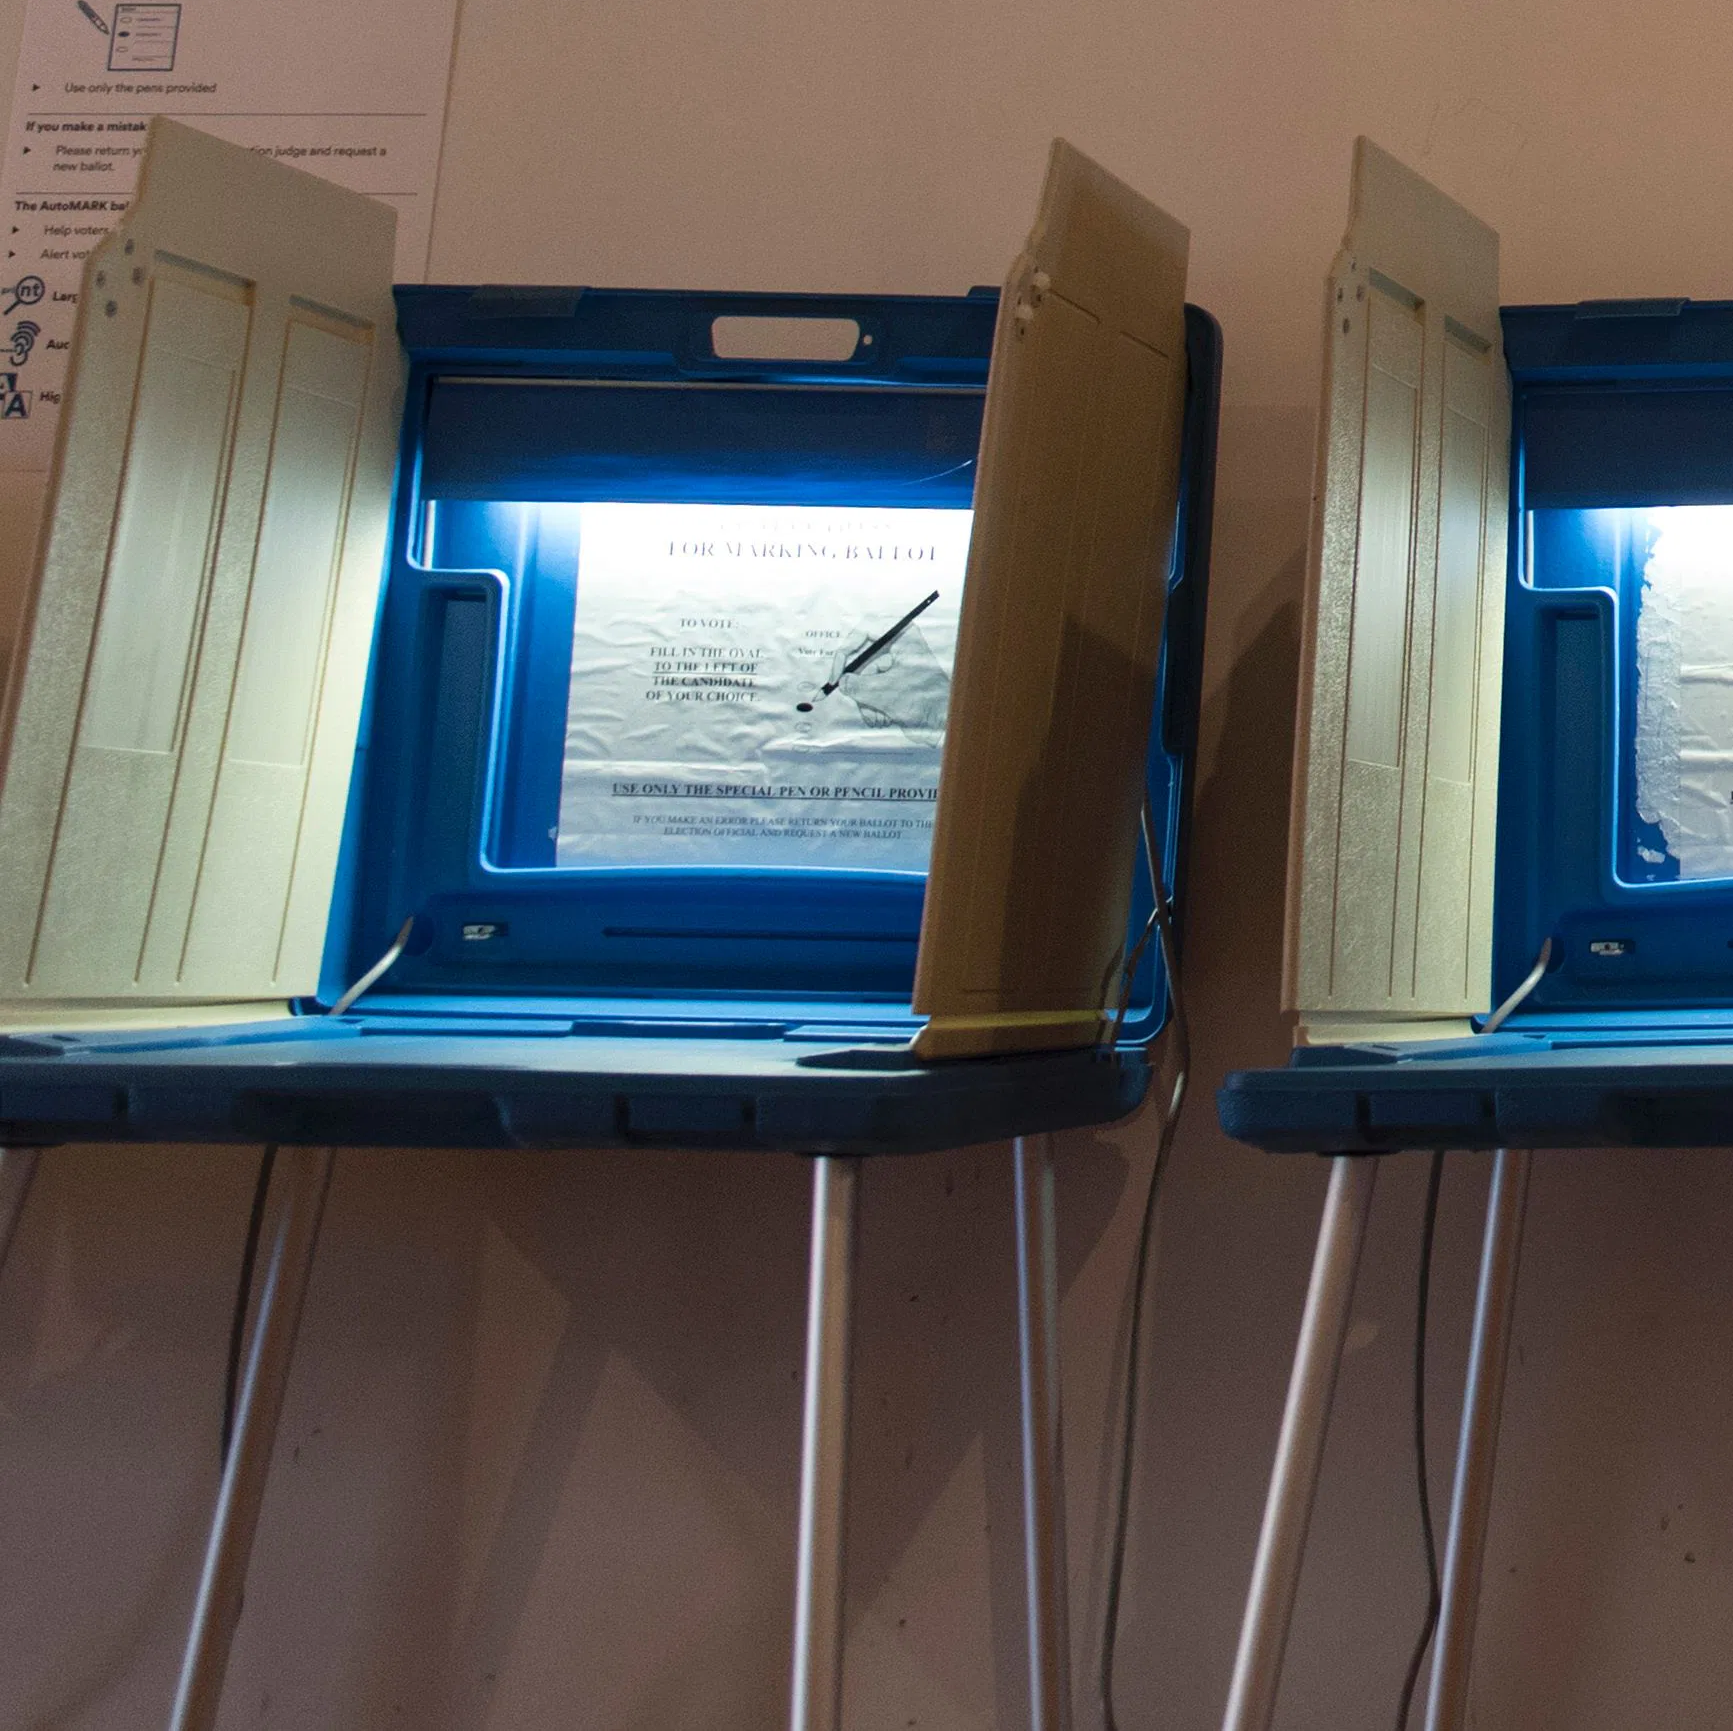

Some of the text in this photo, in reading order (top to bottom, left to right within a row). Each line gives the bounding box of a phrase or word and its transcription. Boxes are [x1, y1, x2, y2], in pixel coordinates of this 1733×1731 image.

[65, 83, 216, 94] Use only the pens provided
[26, 122, 35, 131] If
[38, 124, 59, 133] you
[62, 122, 94, 131] make
[107, 122, 147, 131] mistak
[56, 146, 91, 156] Please
[95, 146, 130, 156] return
[274, 146, 306, 158] judge
[310, 146, 330, 156] and
[334, 146, 375, 159] request
[378, 148, 386, 156] a
[81, 162, 114, 171] ballot.
[15, 201, 37, 211] The
[41, 201, 106, 211] AutoMARK
[44, 226, 71, 237] Help
[41, 249, 69, 259] Alert
[670, 541, 935, 560] FOR MARKING BALLOT
[613, 783, 937, 799] USE ONLY THE SPECIAL PEN OR PENCIL PROVI
